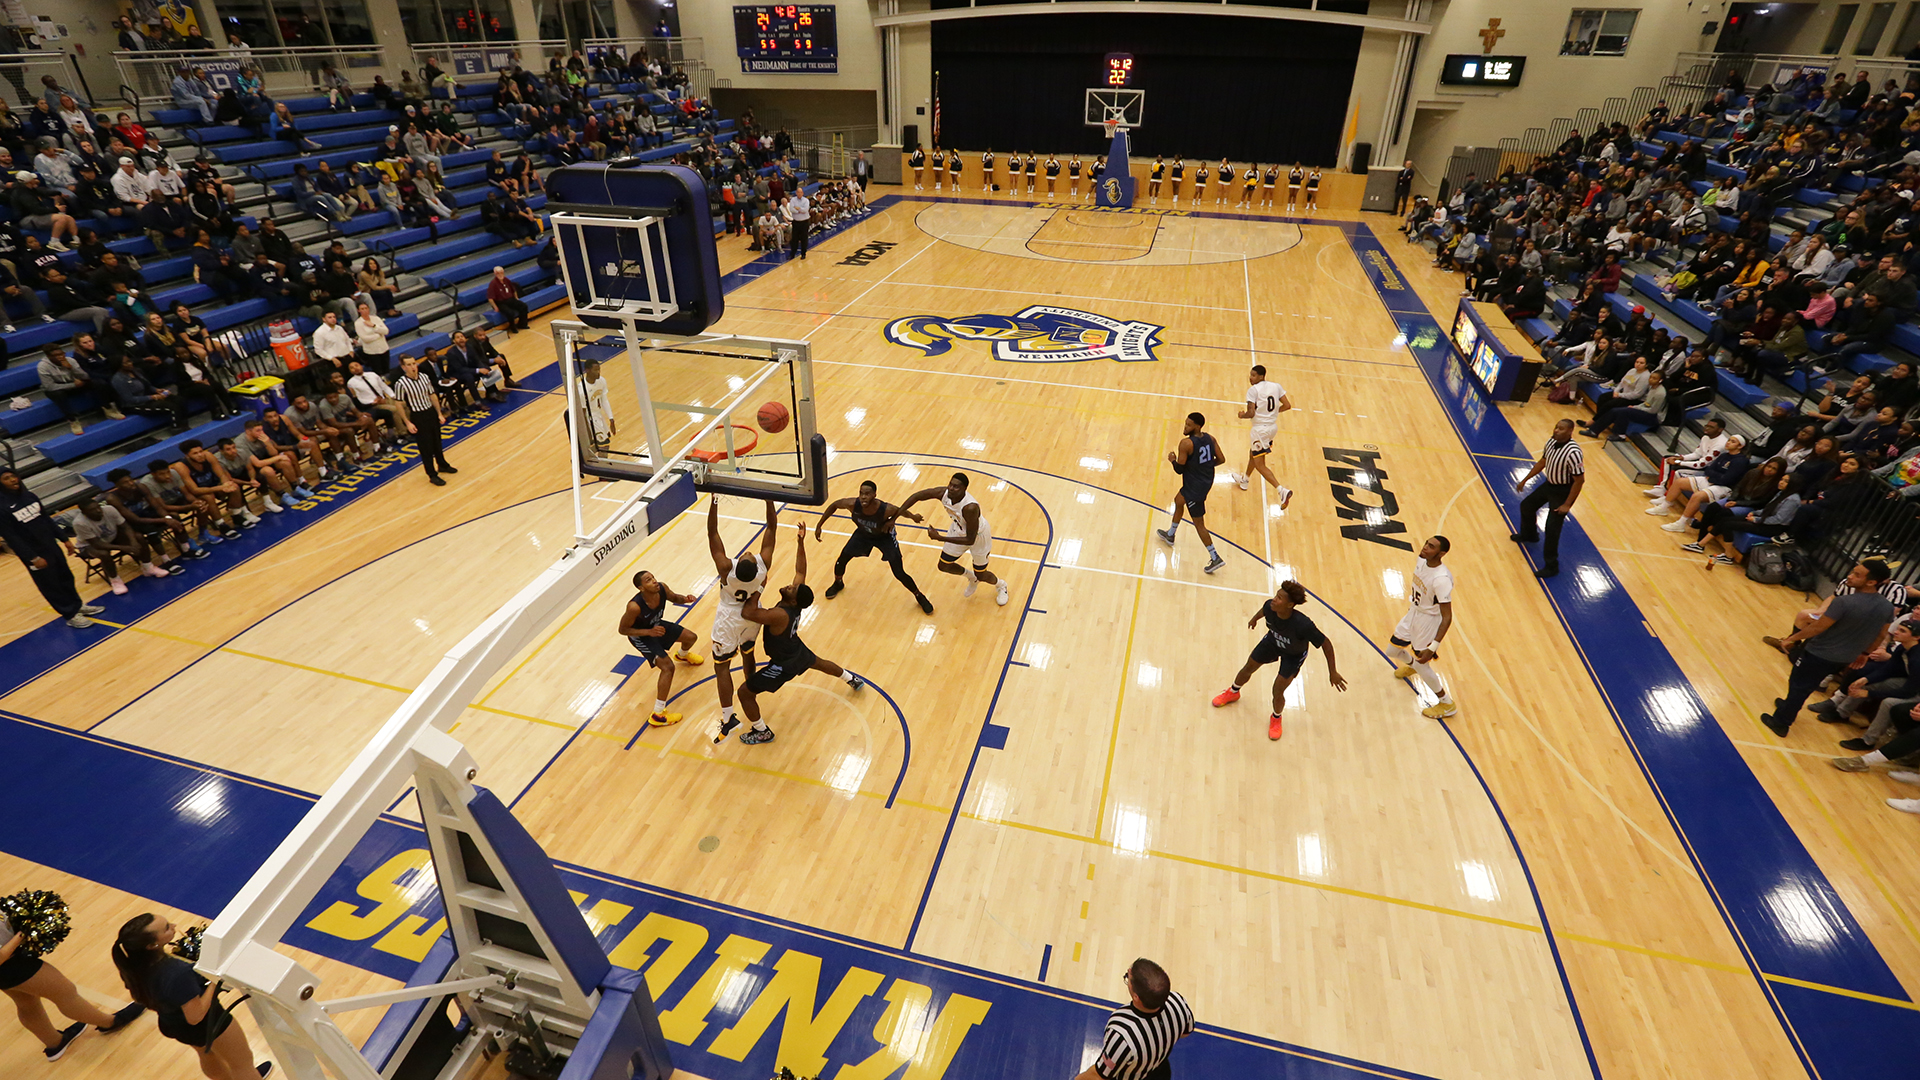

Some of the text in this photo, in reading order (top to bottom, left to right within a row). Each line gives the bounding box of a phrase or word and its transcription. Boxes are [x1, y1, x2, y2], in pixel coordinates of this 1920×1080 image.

[775, 5, 796, 18] 4:12
[757, 13, 770, 25] 24
[799, 13, 813, 25] 26
[760, 39, 767, 49] 5
[769, 39, 777, 49] 5
[794, 39, 802, 49] 5
[805, 39, 812, 49] 9
[453, 52, 482, 60] SECTION
[464, 60, 476, 73] E
[751, 60, 789, 70] NEUMANN
[790, 61, 802, 69] HOME
[808, 61, 817, 69] THE
[1109, 58, 1132, 70] 4:12
[211, 73, 232, 90] D
[1108, 69, 1126, 85] 22
[1033, 202, 1192, 217] NEUMANN
[836, 240, 899, 266] NCAA
[34, 253, 60, 267] KEAN
[1040, 306, 1119, 329] UNIVERSITY
[1123, 323, 1150, 357] KNIGHTS
[1017, 348, 1108, 361] NEUMANN
[1266, 395, 1276, 413] 0
[1198, 444, 1212, 464] 21
[1321, 446, 1415, 553] NCAA
[593, 519, 637, 567] SPALDING
